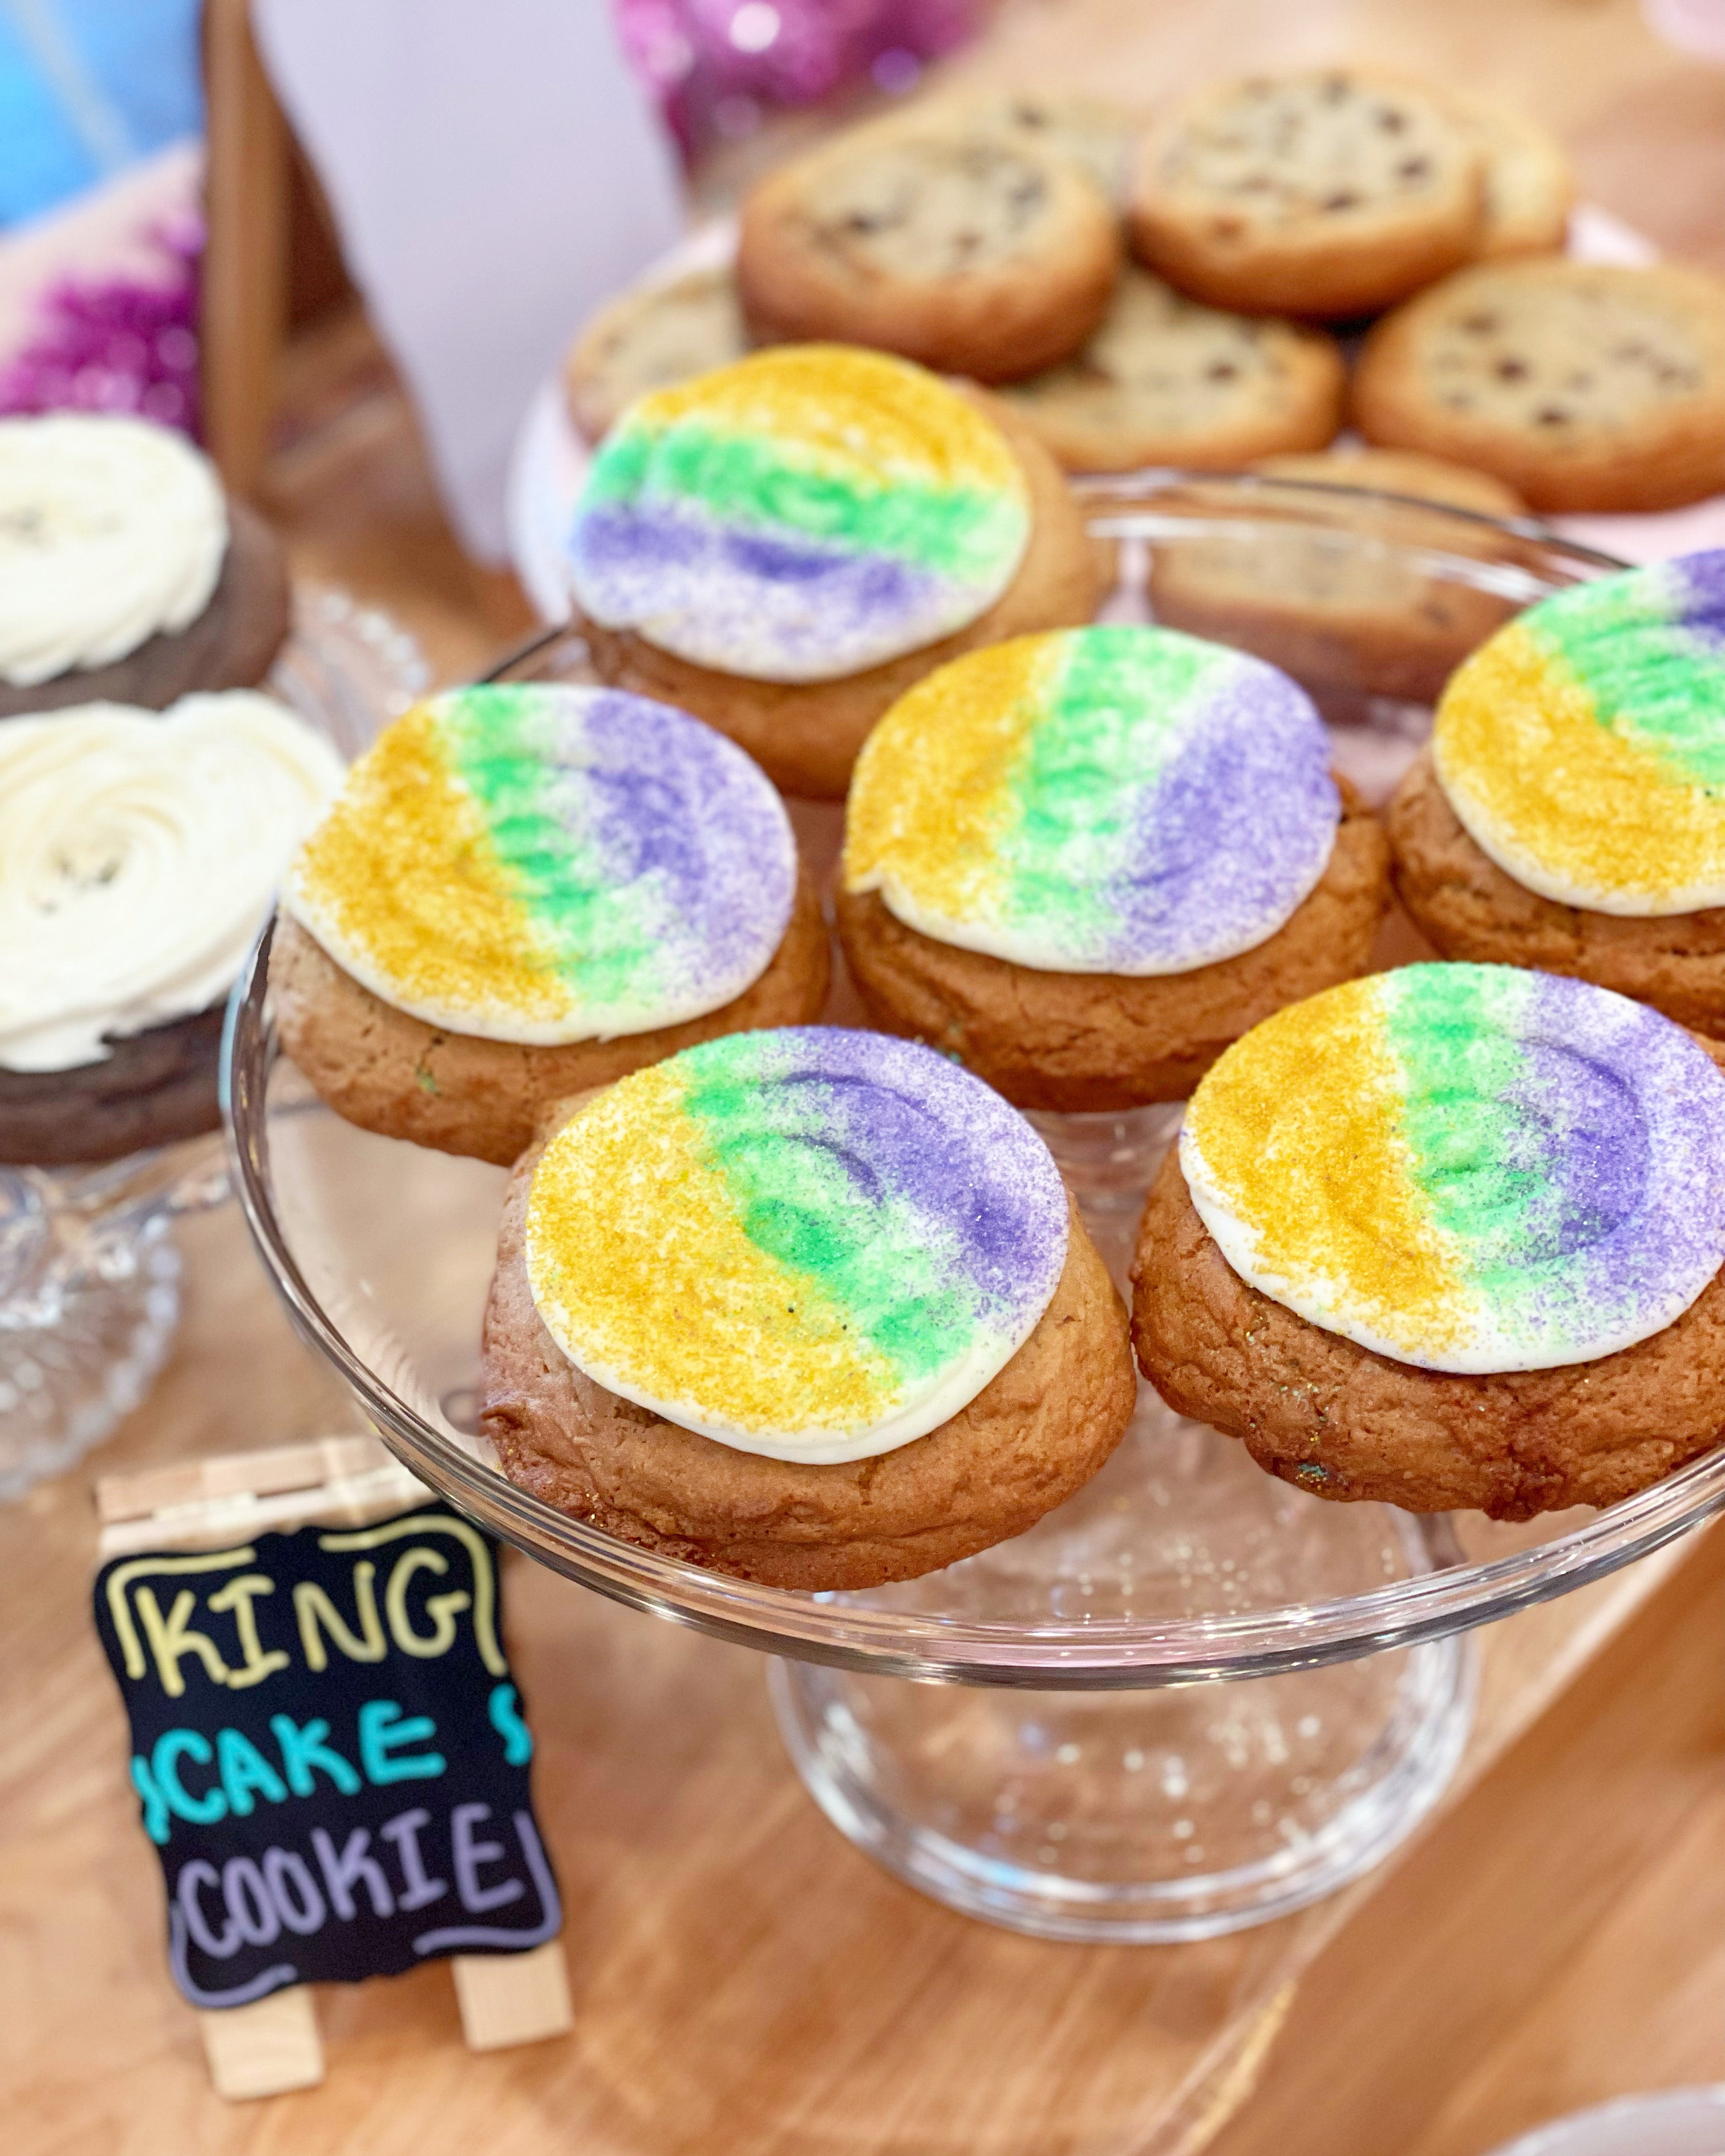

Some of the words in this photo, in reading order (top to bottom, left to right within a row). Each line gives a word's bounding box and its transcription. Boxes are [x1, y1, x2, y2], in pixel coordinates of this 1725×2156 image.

[134, 1547, 472, 1697] KING
[152, 1700, 447, 1823] CAKE
[176, 1802, 525, 1959] COOKIE
